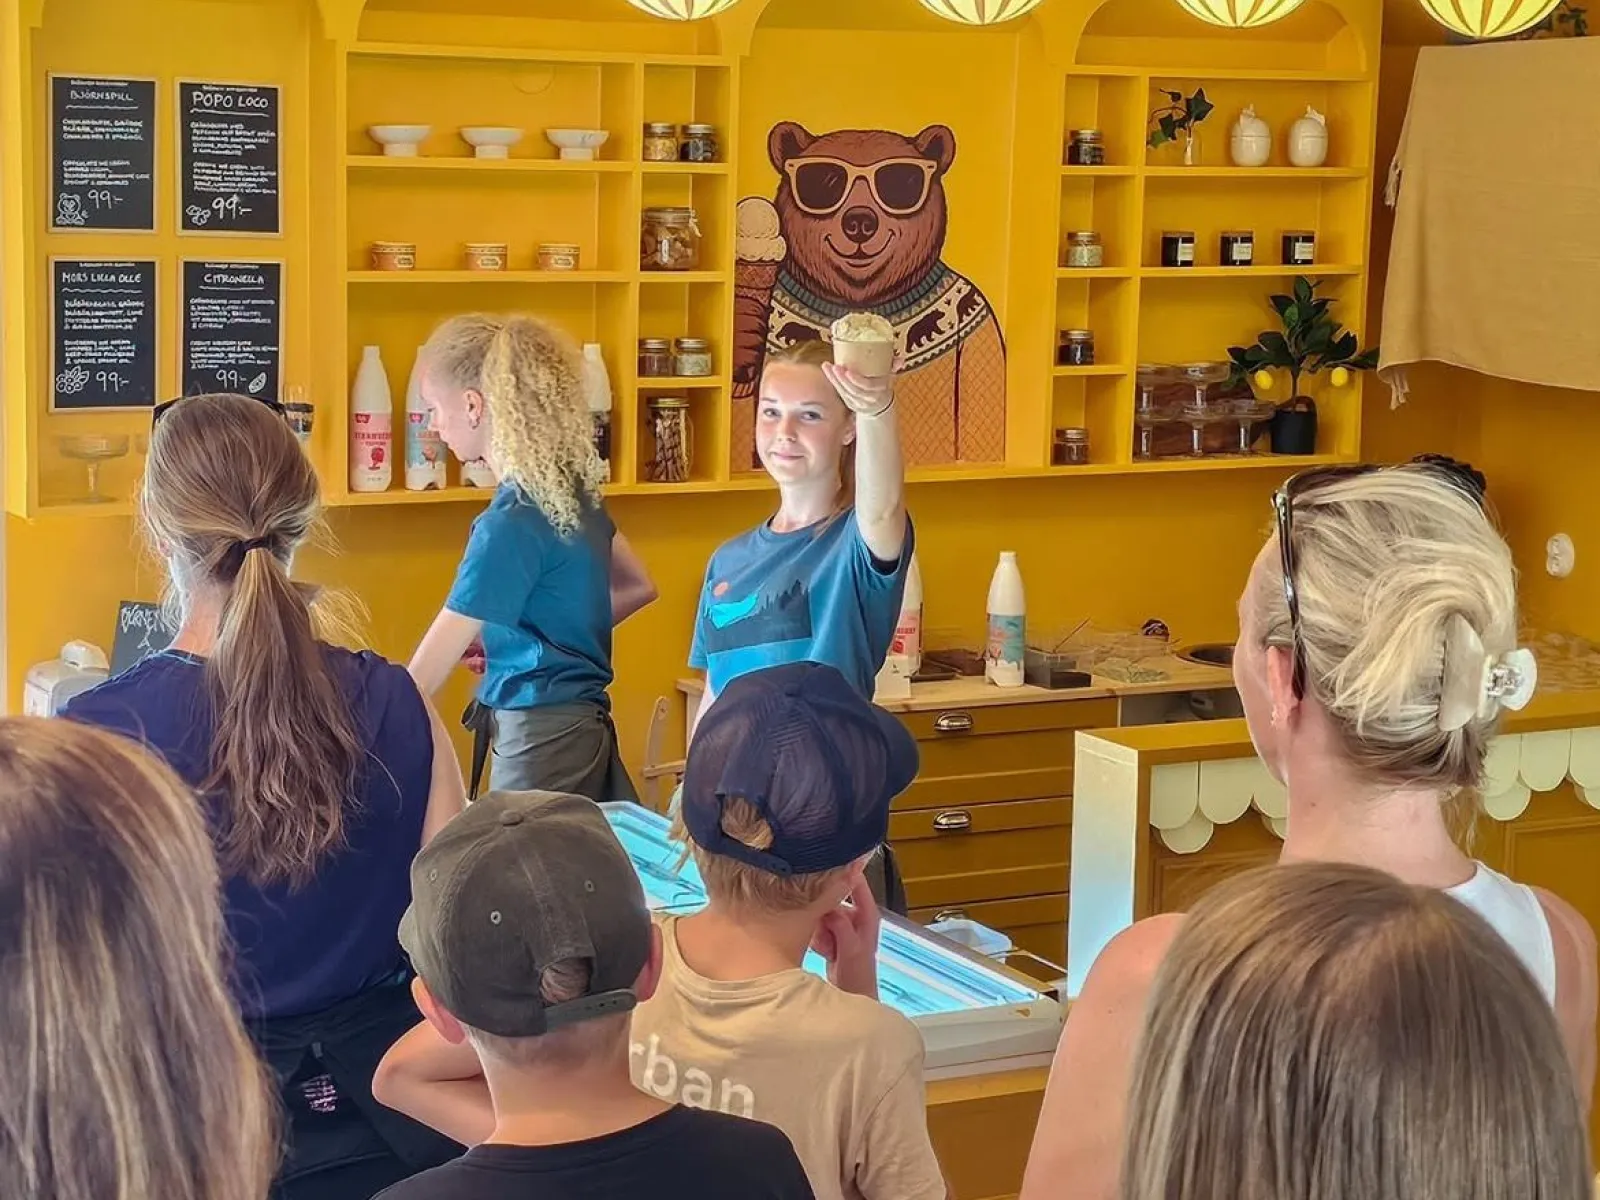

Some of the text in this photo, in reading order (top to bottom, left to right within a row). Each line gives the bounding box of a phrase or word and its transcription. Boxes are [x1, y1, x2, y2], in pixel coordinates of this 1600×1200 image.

[192, 91, 269, 108] POPO LOCO
[62, 272, 88, 283] MORS
[203, 273, 265, 285] CITRONELLA
